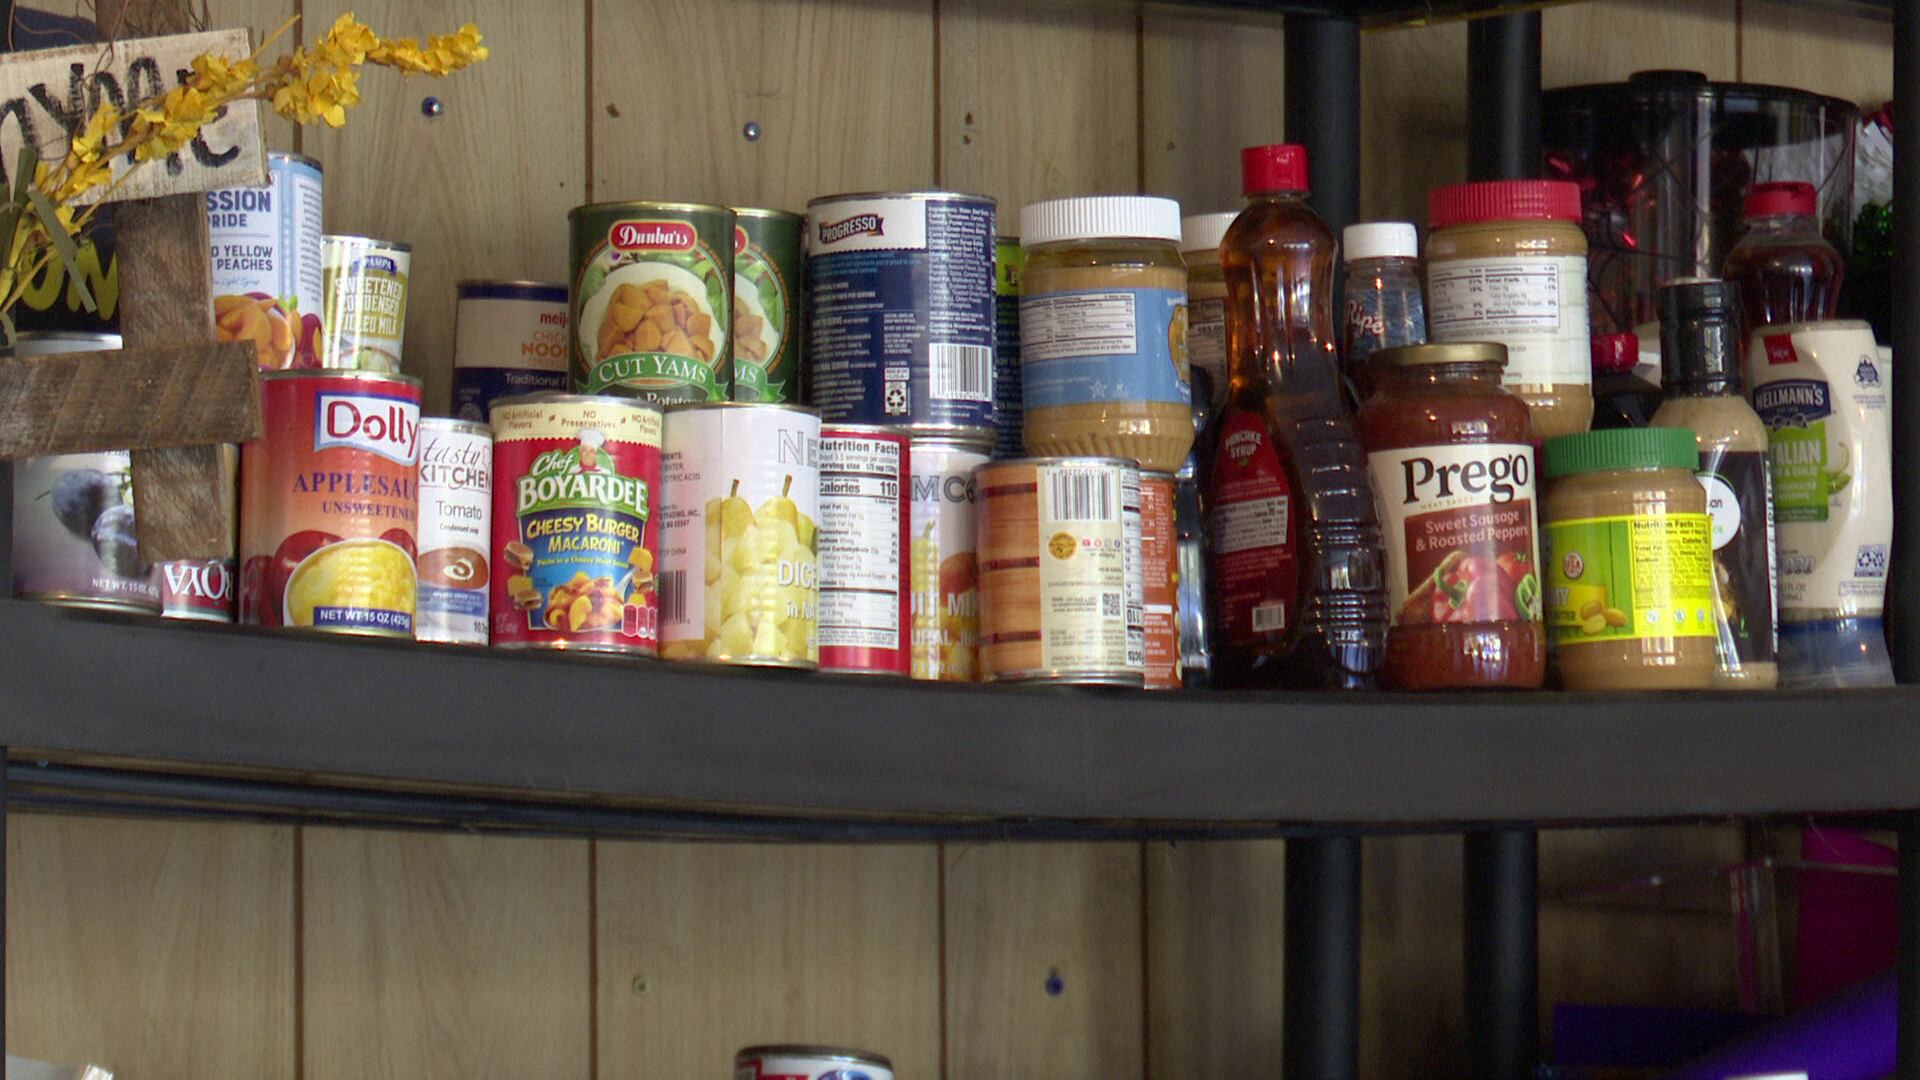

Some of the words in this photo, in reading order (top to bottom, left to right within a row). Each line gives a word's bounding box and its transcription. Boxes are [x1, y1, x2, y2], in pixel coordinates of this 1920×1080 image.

[208, 213, 248, 228] RIDE
[822, 216, 876, 242] PROGRESSO
[224, 244, 273, 258] YELLOW
[217, 259, 273, 271] PEACHES
[335, 276, 404, 301] SWETENED
[338, 293, 400, 318] ODENSED
[336, 312, 377, 334] ILED
[504, 372, 561, 386] Traditional
[599, 357, 645, 384] CUT
[653, 354, 708, 384] YAMS
[512, 409, 543, 420] Artificial
[582, 410, 596, 419] NO
[631, 414, 642, 423] NO
[561, 417, 616, 429] Preservatives
[327, 401, 418, 459] Dolly
[874, 443, 898, 455] Facts
[1225, 430, 1263, 452] PANCAKE
[1230, 444, 1258, 458] SYRUP
[423, 436, 481, 471] tasty
[533, 451, 575, 477] Chef
[821, 463, 844, 471] erving
[880, 481, 897, 496] 110
[1401, 454, 1529, 504] Prego
[518, 474, 648, 516] BOYARDEE
[435, 500, 483, 521] Tomato
[526, 515, 585, 539] CHEESY
[586, 513, 640, 543] BURGER
[1425, 518, 1468, 534] Sweet
[1470, 510, 1520, 528] Sausage
[1633, 521, 1673, 529] Nutrition
[548, 534, 621, 555] MACARONI
[1415, 538, 1426, 552] &
[1429, 530, 1485, 549] Roasted
[1488, 525, 1528, 542] Peppers
[320, 609, 343, 621] NET
[345, 610, 362, 622] WT
[364, 612, 375, 622] 15
[376, 613, 390, 624] OZ
